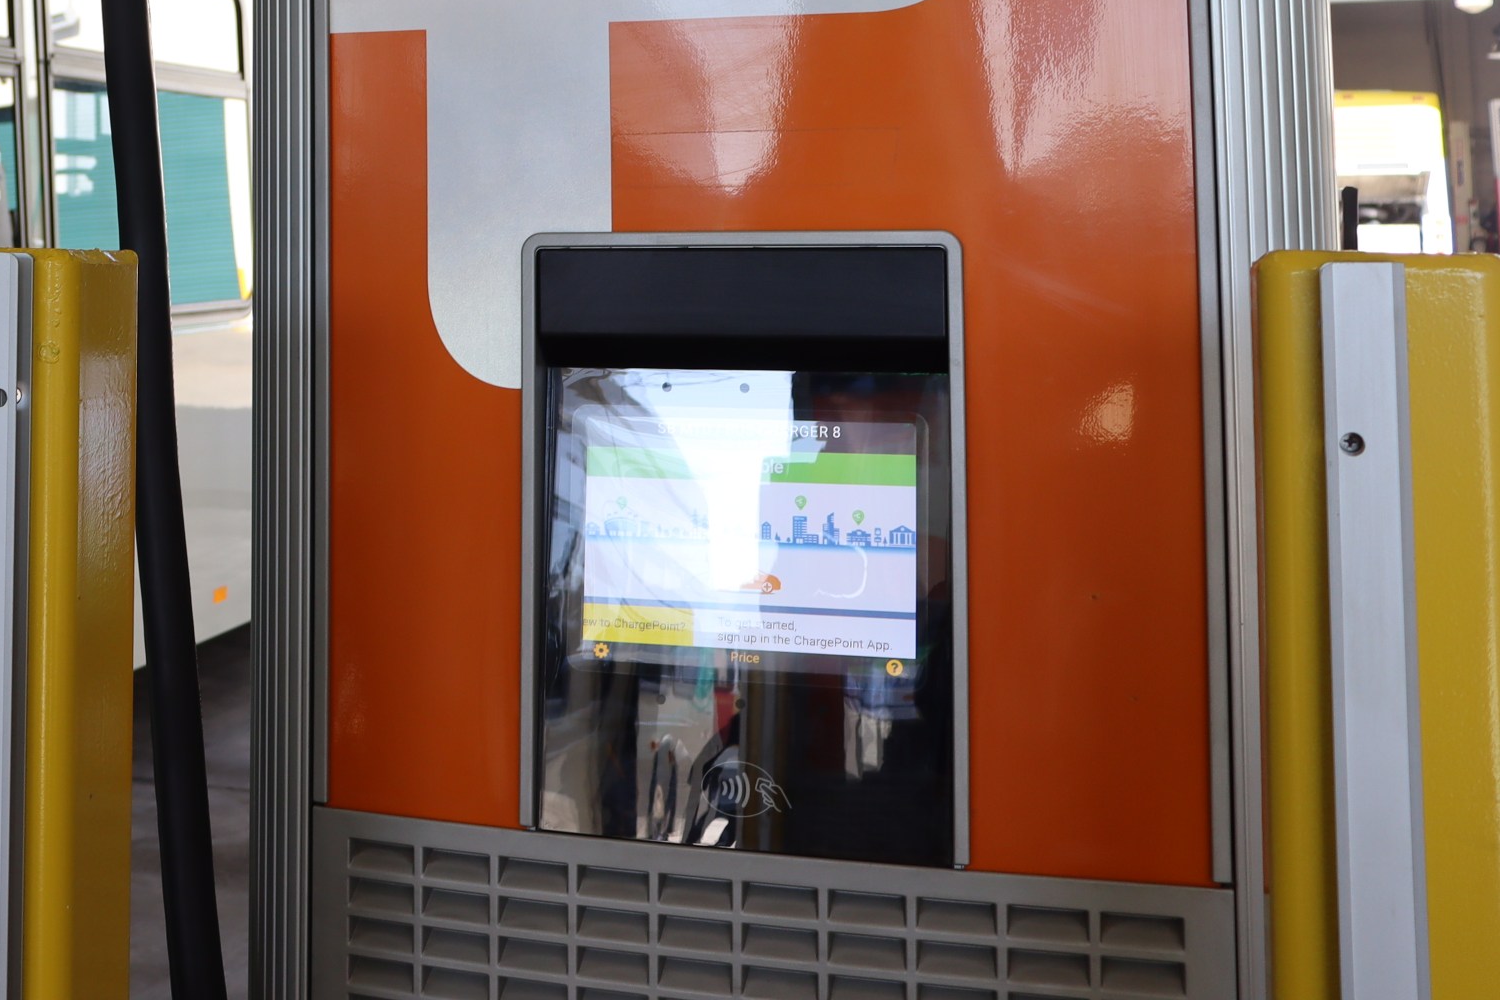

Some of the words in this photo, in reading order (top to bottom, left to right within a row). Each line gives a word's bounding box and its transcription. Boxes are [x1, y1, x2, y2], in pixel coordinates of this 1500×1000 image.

[832, 426, 841, 438] 8
[600, 618, 611, 627] to
[614, 617, 686, 632] ChargePoint?
[717, 632, 740, 644] sign
[743, 635, 757, 645] up
[760, 634, 770, 644] in
[773, 634, 791, 645] the
[794, 635, 863, 649] ChargePoint
[866, 639, 893, 653] App.
[730, 651, 760, 664] Price
